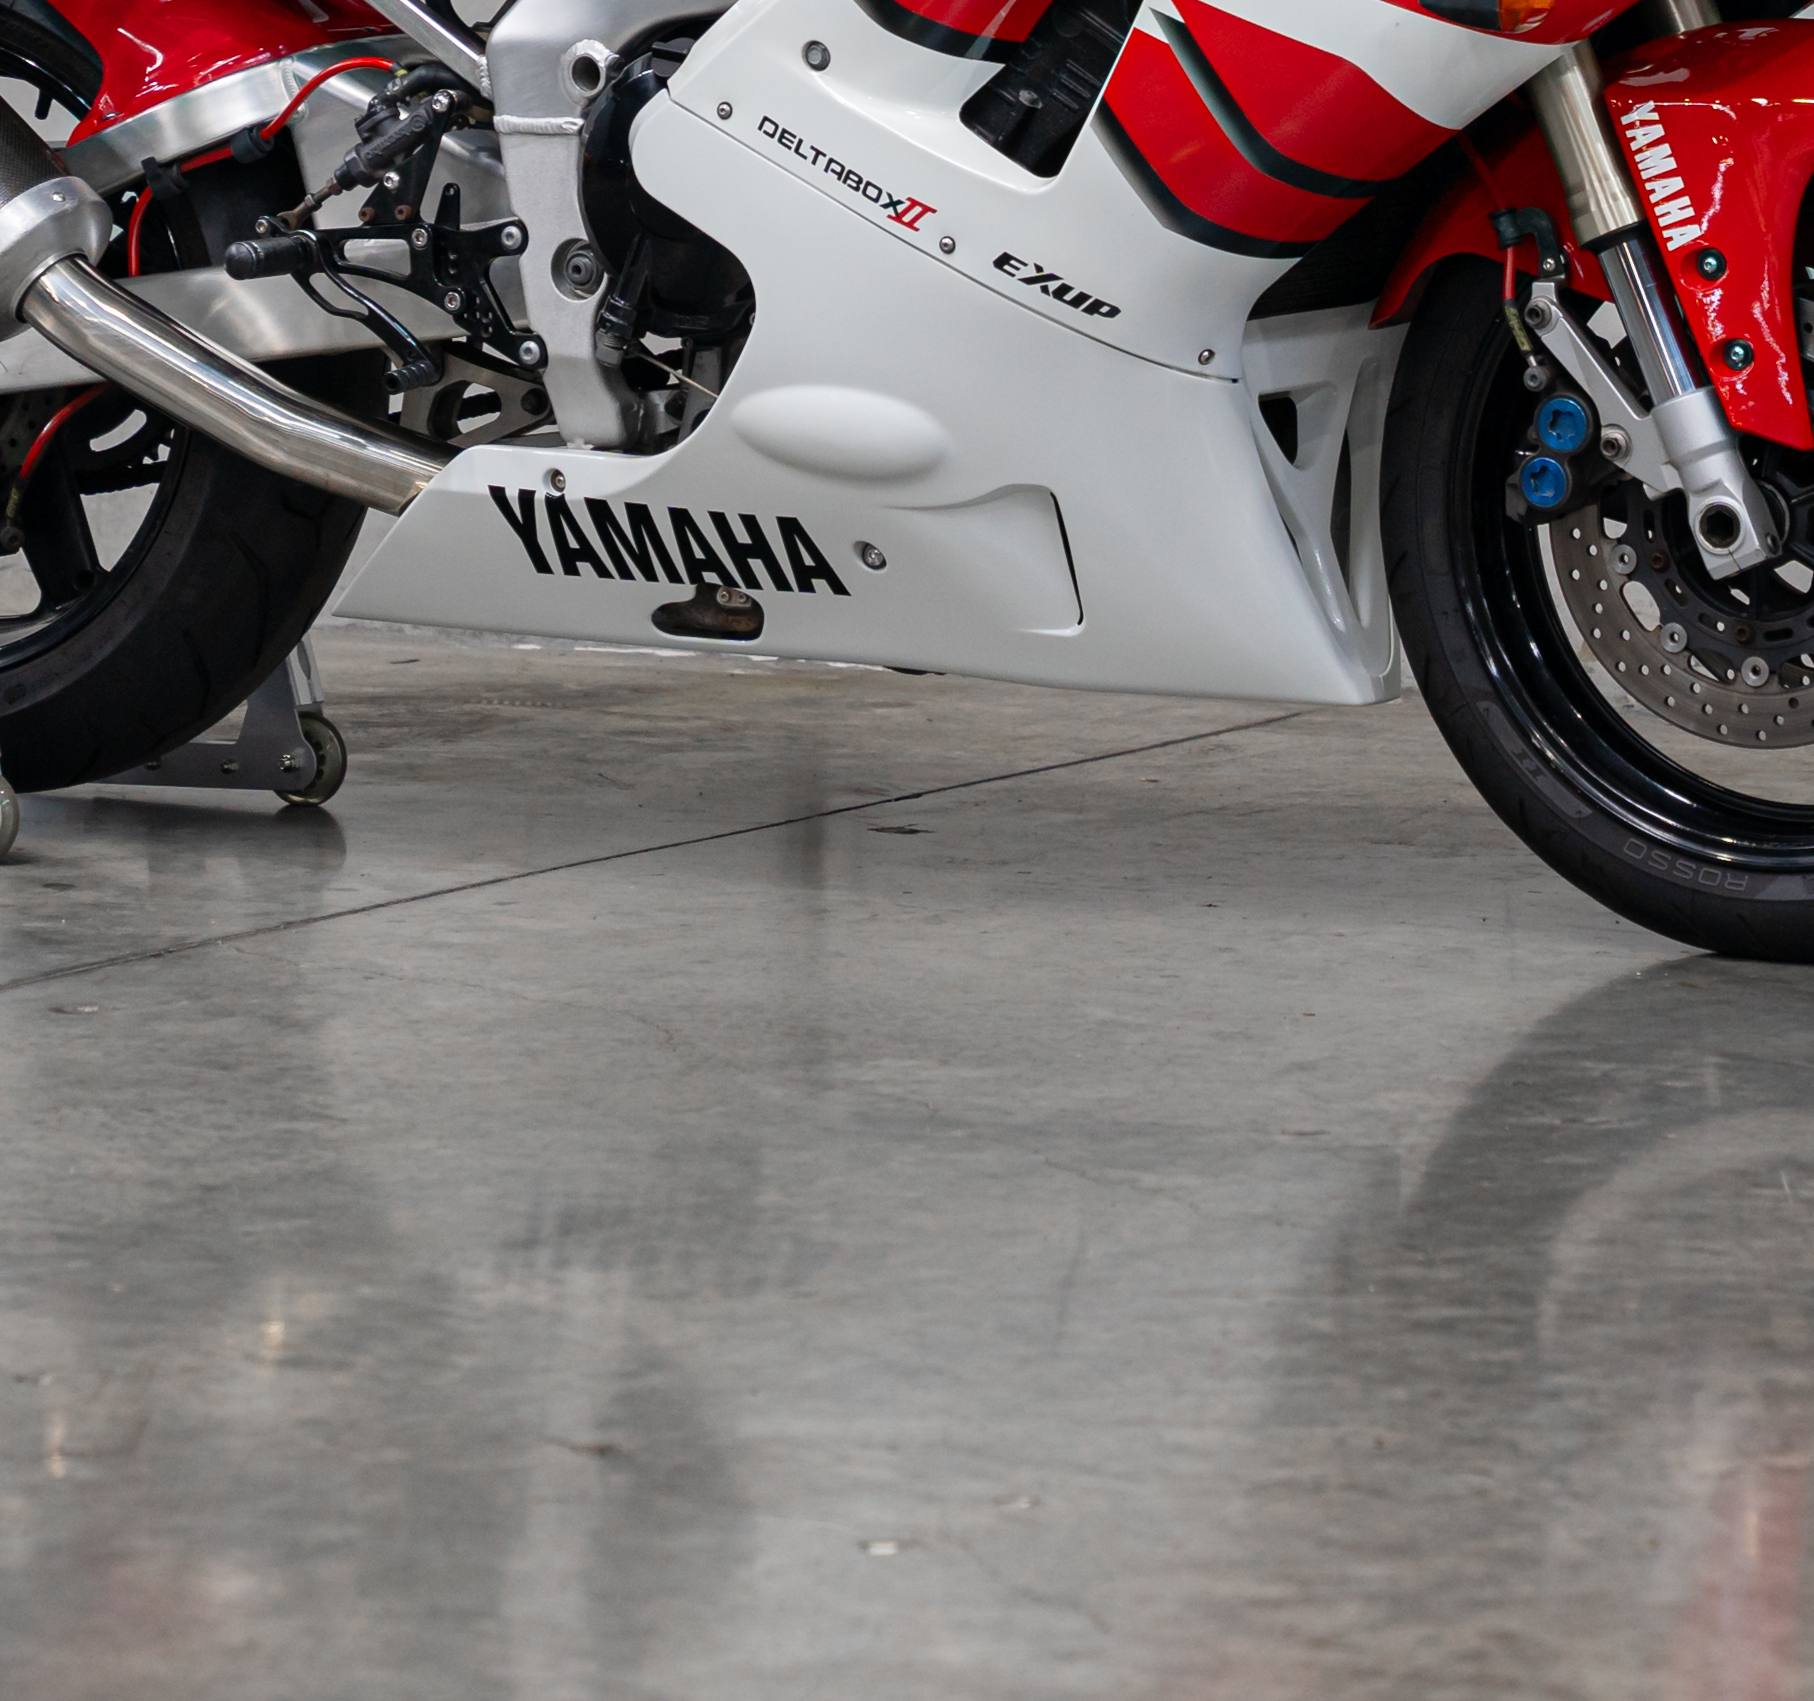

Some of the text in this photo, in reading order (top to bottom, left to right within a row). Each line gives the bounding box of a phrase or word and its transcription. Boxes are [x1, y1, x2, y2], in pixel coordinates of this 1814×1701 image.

[1619, 99, 1704, 253] YAMAHA
[992, 251, 1122, 318] EXUP
[487, 484, 852, 597] YAMAHA
[1622, 837, 1751, 894] ROSSO
